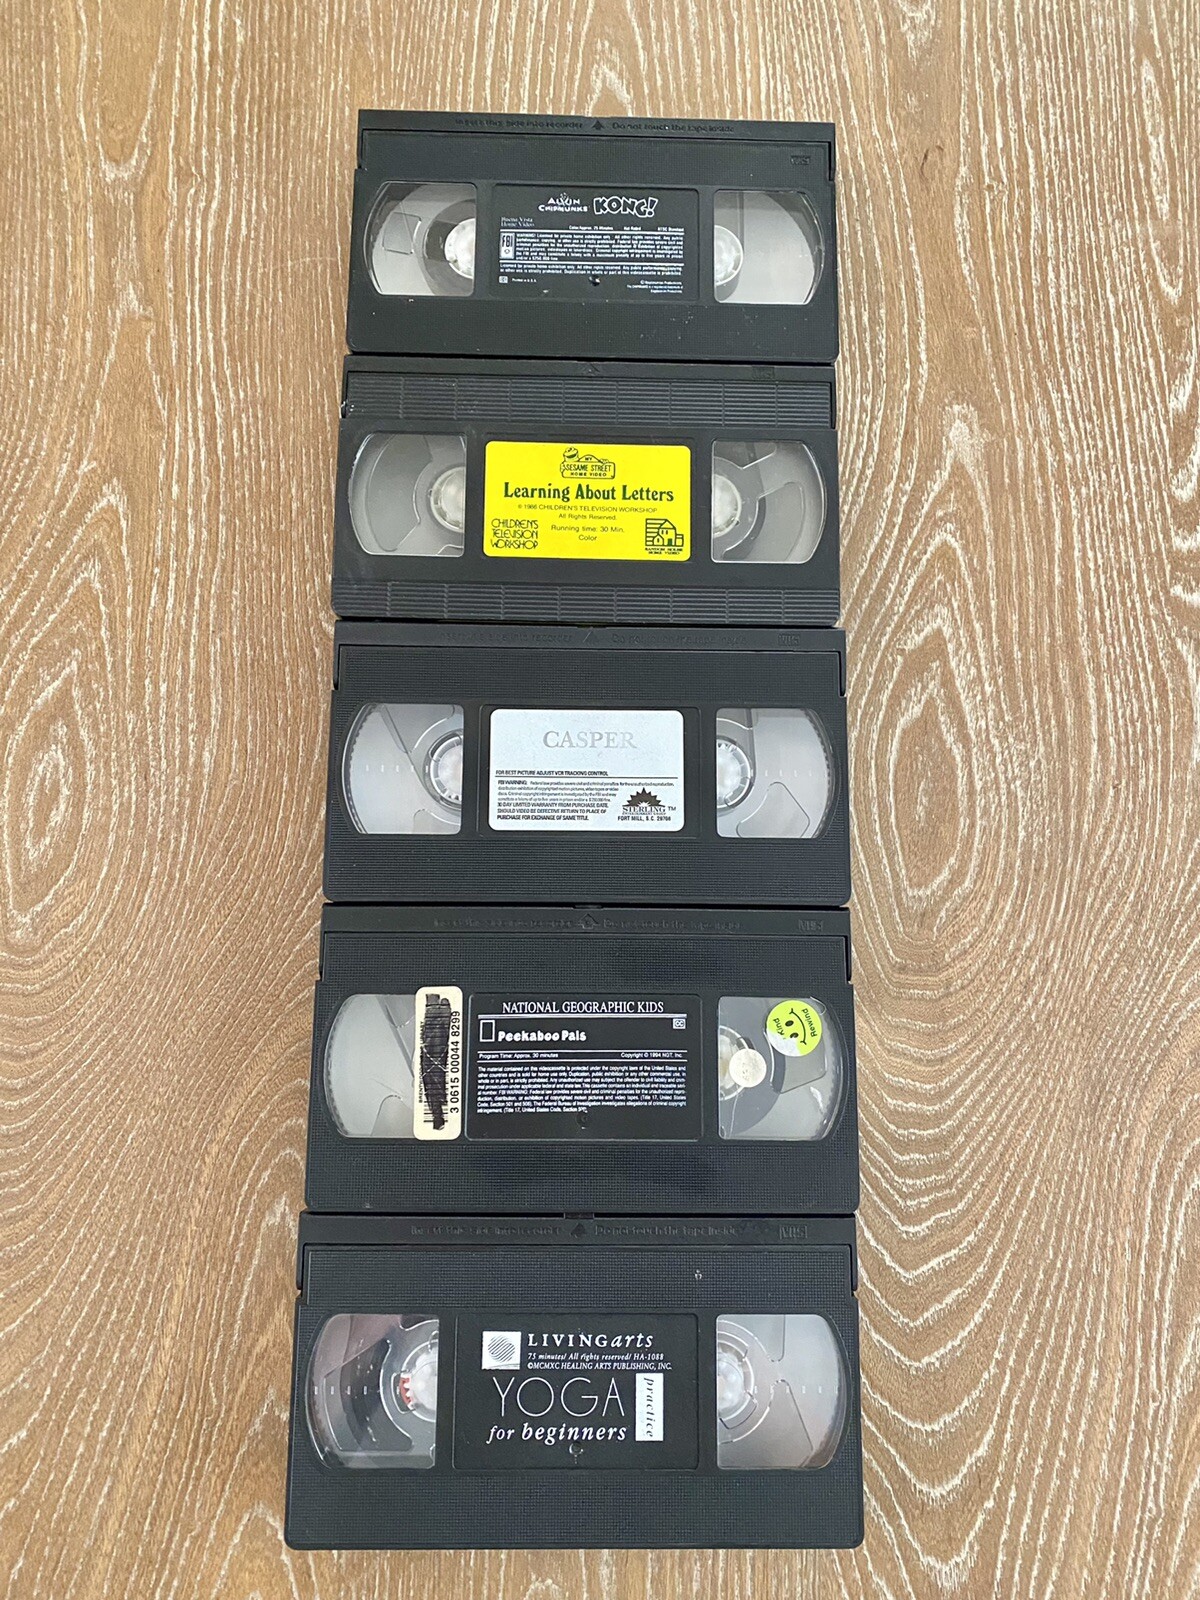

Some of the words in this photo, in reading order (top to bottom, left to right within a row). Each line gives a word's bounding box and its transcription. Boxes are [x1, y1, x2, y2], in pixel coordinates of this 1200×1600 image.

[538, 204, 588, 212] CHIPMUNKS
[593, 196, 659, 218] KONG!
[502, 235, 513, 247] FBI
[566, 464, 588, 472] SESAME
[591, 464, 611, 472] STREET
[504, 482, 570, 503] Learning
[575, 483, 616, 500] About
[622, 484, 674, 502] Letters
[491, 528, 538, 539] TELEVISION
[551, 524, 579, 532] Running
[490, 538, 539, 550] WORKSHOP
[542, 730, 637, 749] CASPER
[502, 1001, 560, 1013] NATIONAL
[562, 1001, 635, 1013] GEOGRAPHIC
[637, 1001, 664, 1013] KIDS
[450, 1010, 461, 1037] 8299
[773, 1017, 785, 1036] Kind
[801, 1008, 818, 1037] Rewind
[497, 1030, 560, 1042] Peekaboo
[561, 1030, 587, 1042] Pals
[450, 1041, 460, 1074] 00044
[450, 1078, 460, 1105] 0615
[527, 1332, 653, 1348] LIVINGarts
[527, 1352, 536, 1360] 75
[568, 1352, 578, 1360] All
[580, 1353, 599, 1361] rights
[561, 1362, 594, 1370] HEALING
[595, 1362, 611, 1370] ARTS
[612, 1362, 657, 1370] PUBLISHING,
[657, 1362, 672, 1370] INC.
[492, 1376, 625, 1417] YOGA
[643, 1377, 655, 1437] practice
[485, 1425, 515, 1445] for
[521, 1422, 627, 1446] beginners
